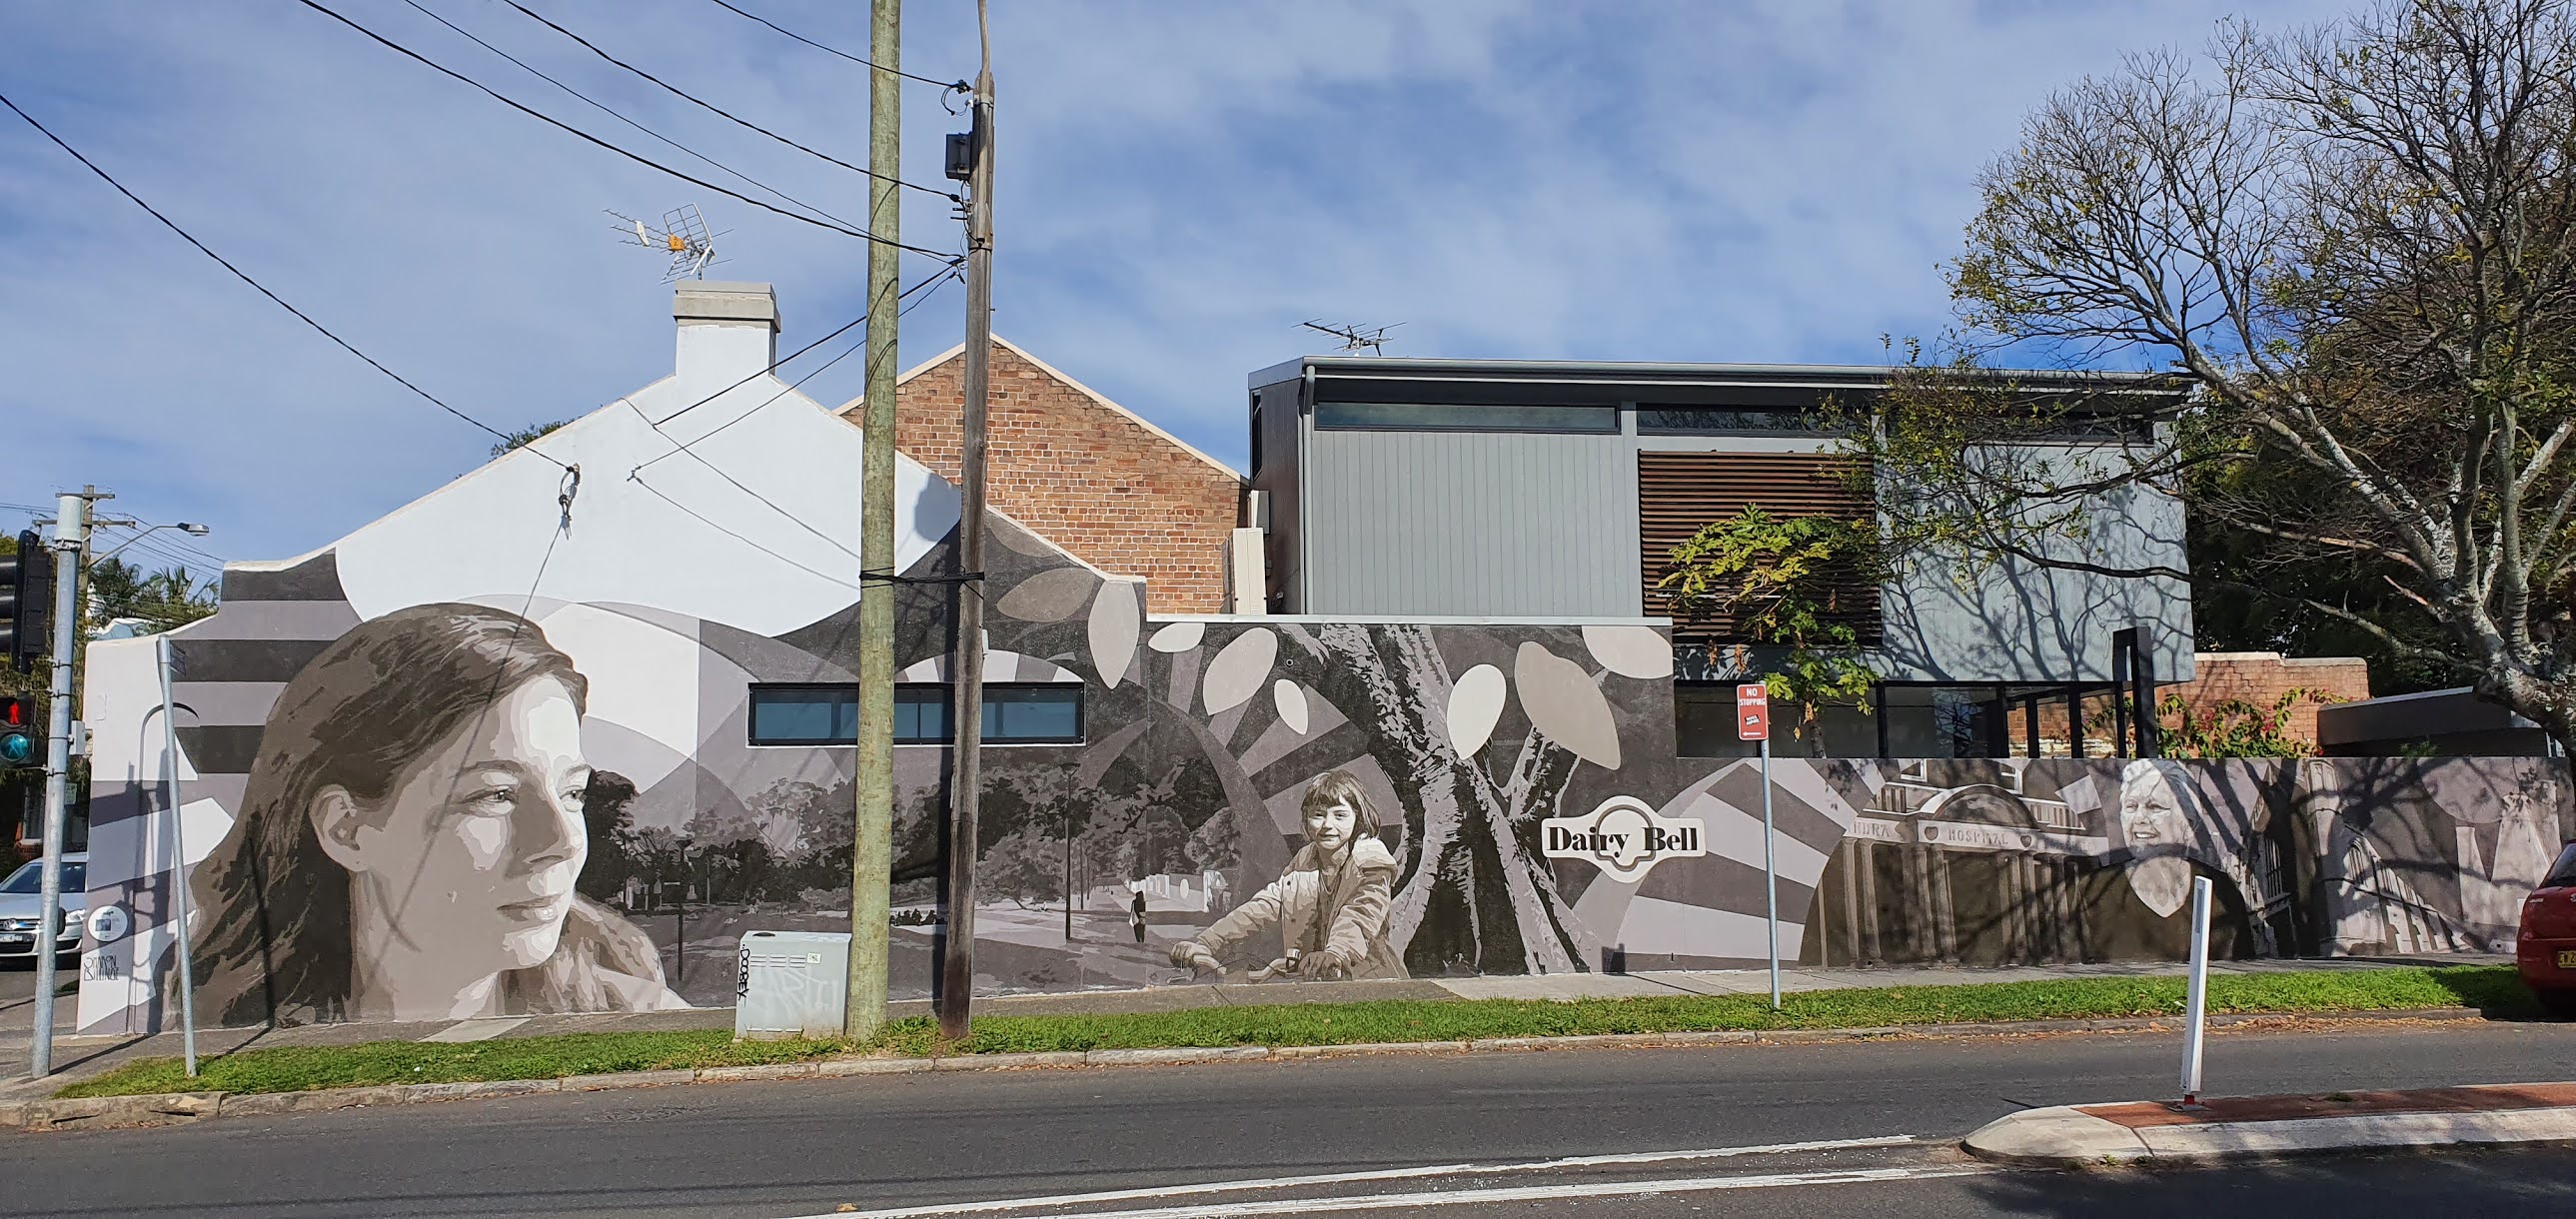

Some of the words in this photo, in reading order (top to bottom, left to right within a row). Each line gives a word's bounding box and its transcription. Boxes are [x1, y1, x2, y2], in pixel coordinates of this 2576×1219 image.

[1746, 687, 1758, 697] NO
[1740, 697, 1766, 706] STOPPING
[1547, 826, 1631, 858] Dairy
[1642, 826, 1698, 851] Bell
[1947, 828, 2008, 845] HOSPITAL
